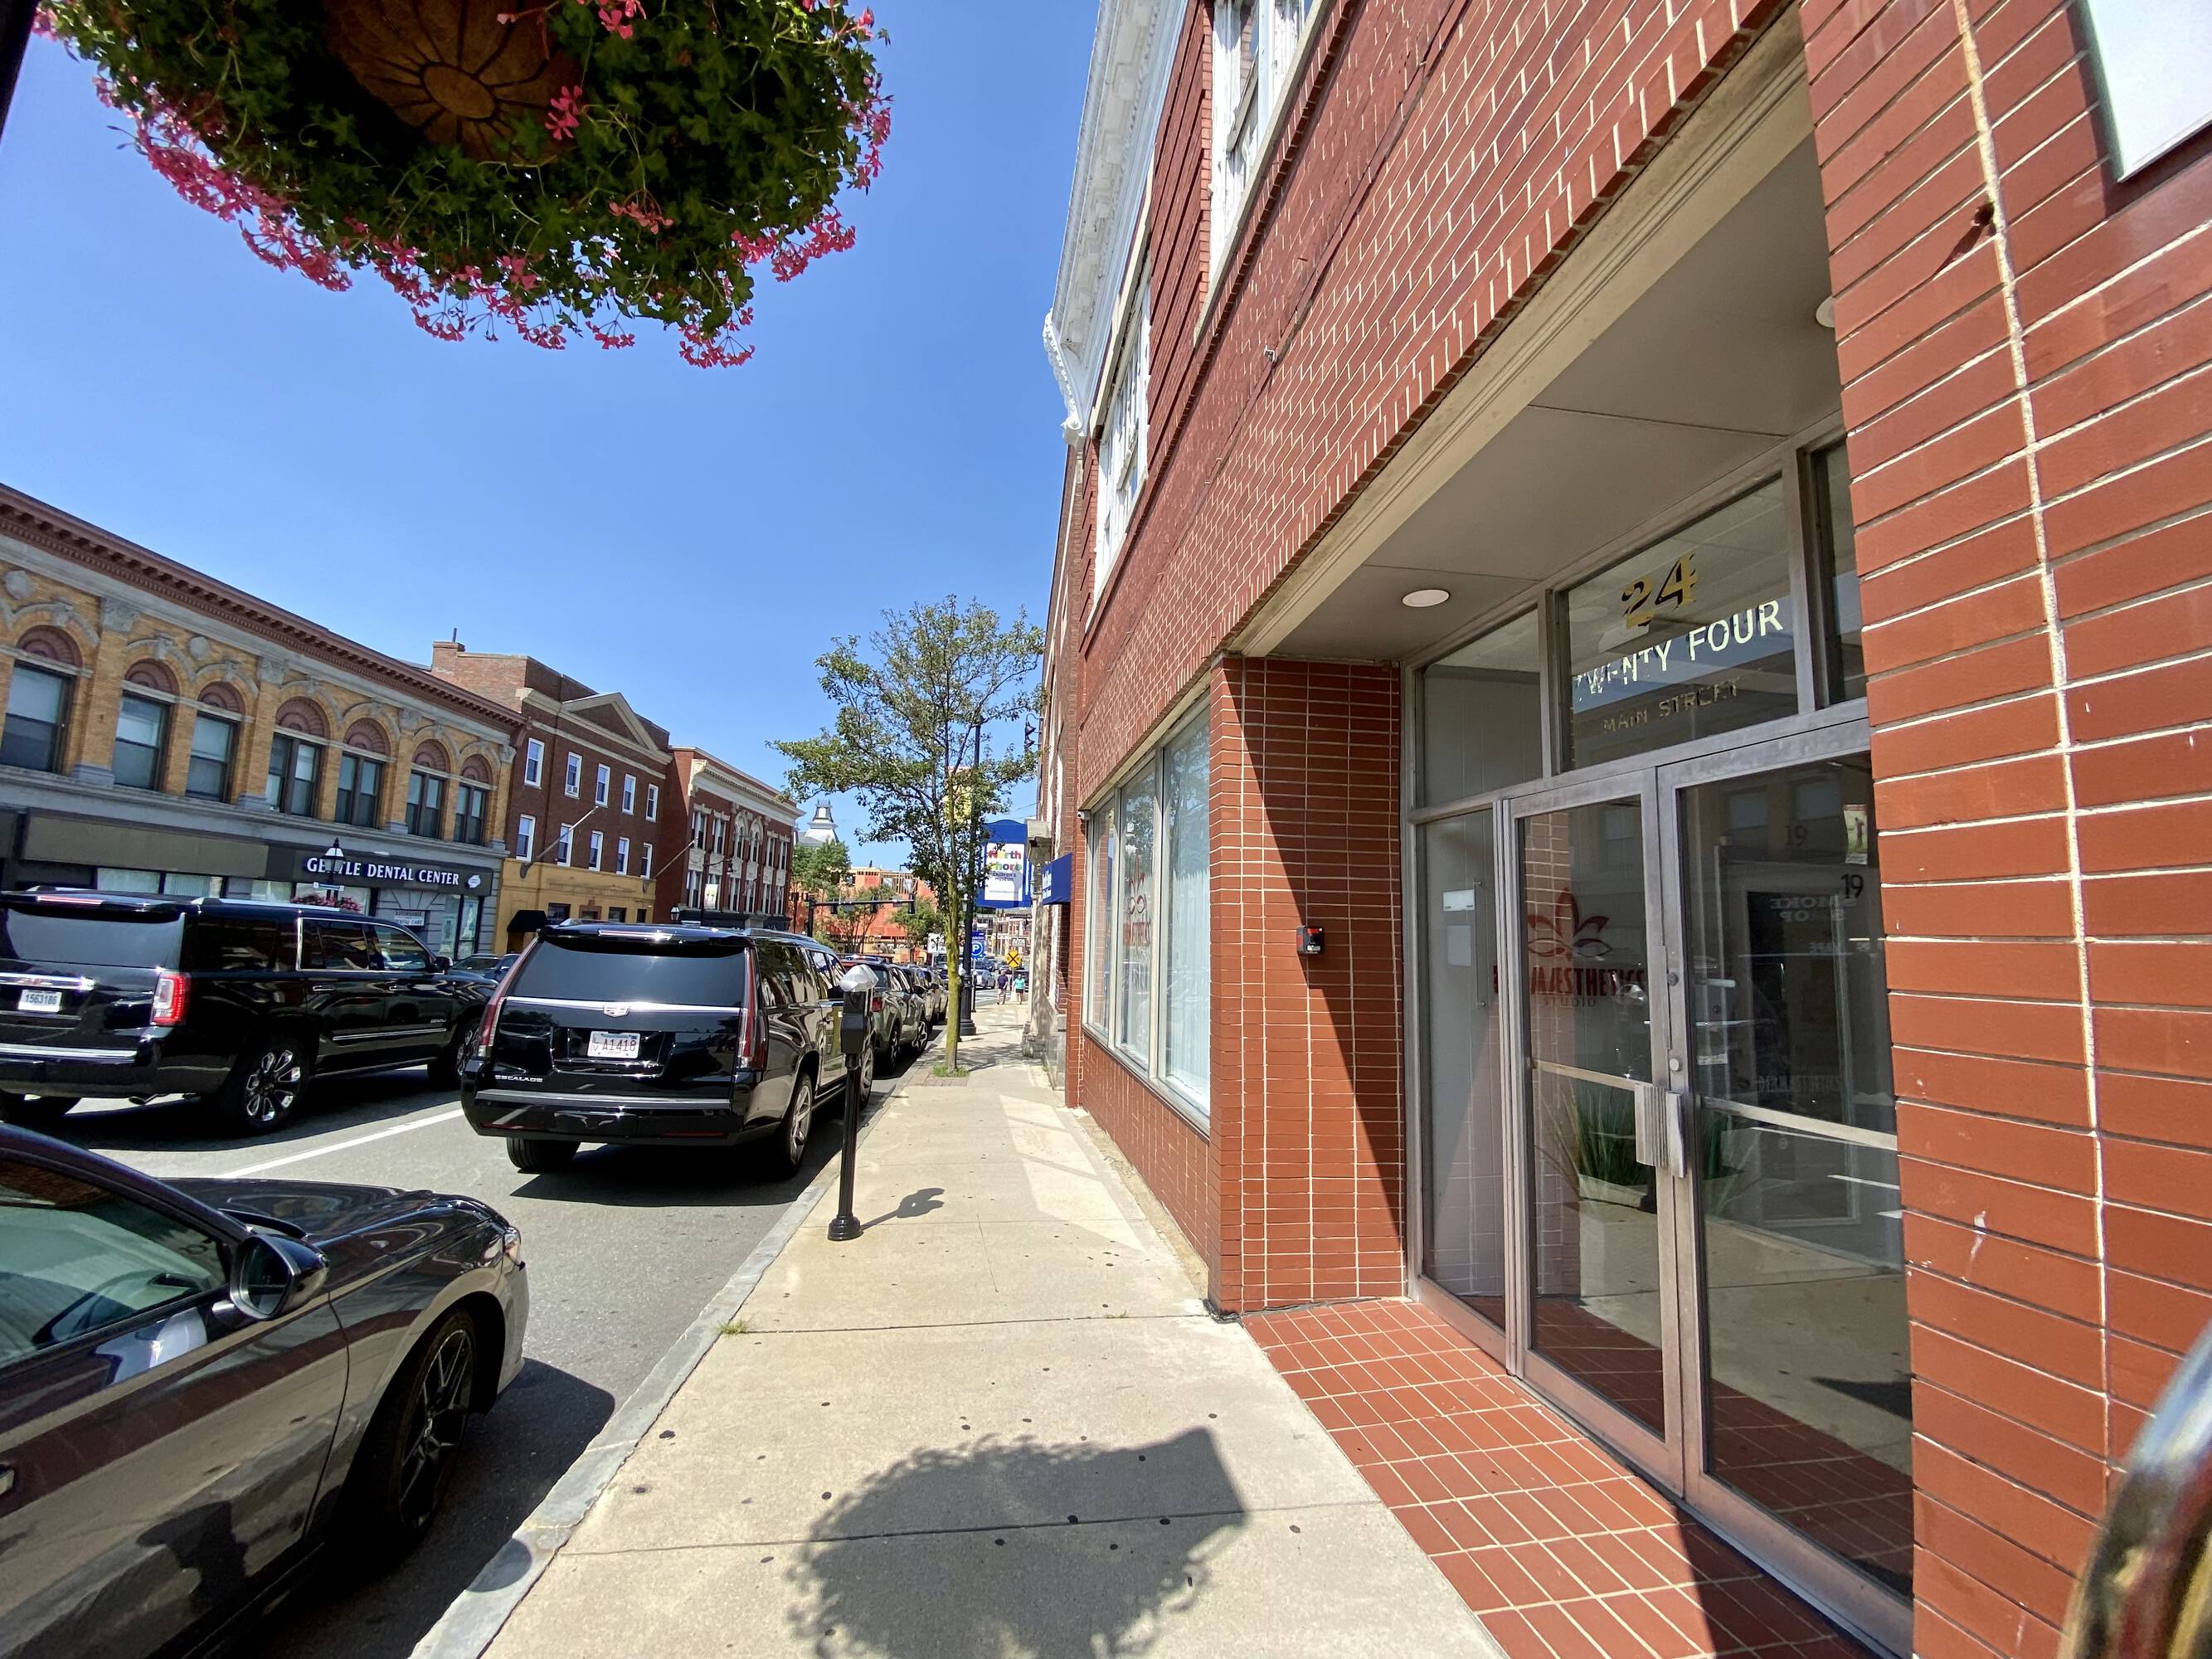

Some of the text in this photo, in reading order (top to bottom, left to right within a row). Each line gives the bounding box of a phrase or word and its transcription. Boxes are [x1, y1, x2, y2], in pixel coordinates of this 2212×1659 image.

[1621, 553, 1699, 629] 24
[1688, 600, 1784, 661] FOUR
[307, 857, 362, 876] GETLE
[367, 864, 414, 881] DENTAL
[418, 869, 459, 885] CENTER
[1841, 873, 1864, 898] 19
[602, 1039, 637, 1051] A1418
